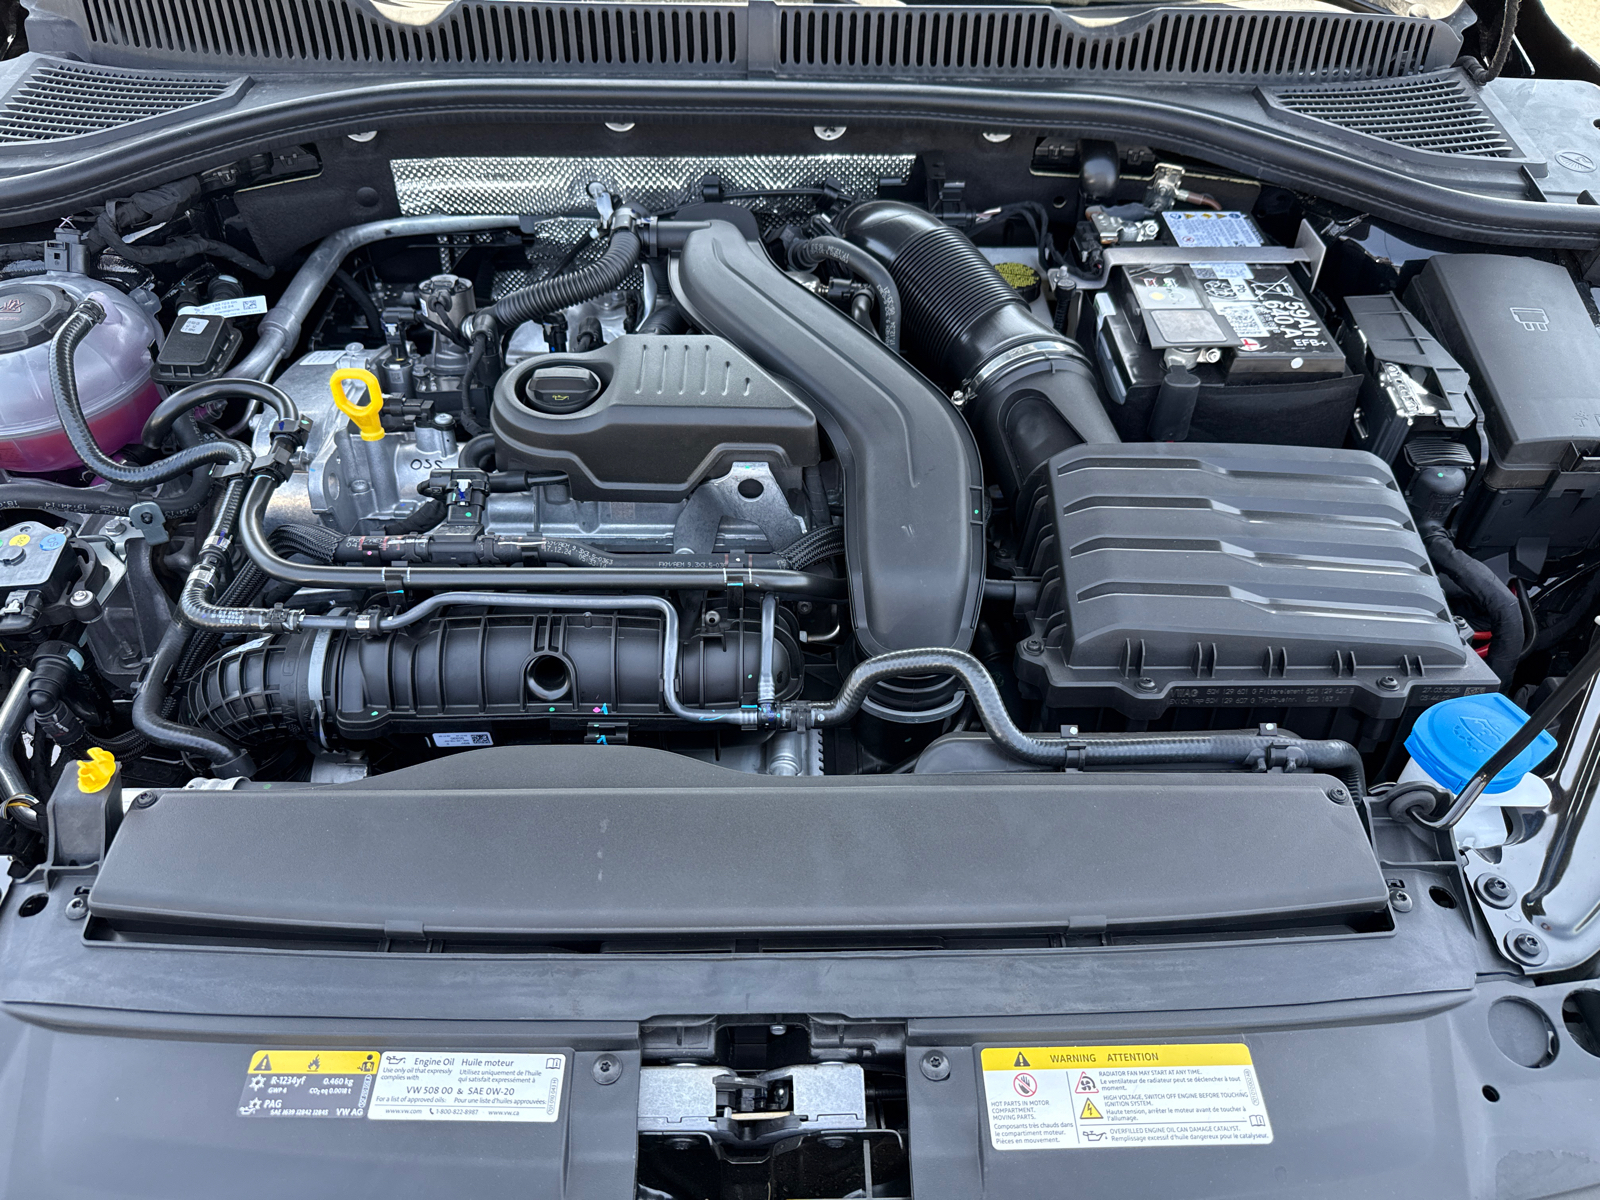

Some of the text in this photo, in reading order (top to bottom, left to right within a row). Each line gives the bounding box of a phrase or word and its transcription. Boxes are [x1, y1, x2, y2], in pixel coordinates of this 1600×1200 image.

[1284, 302, 1321, 336] 59Ah
[1050, 1052, 1159, 1062] WARNING ATTENTION
[414, 1058, 441, 1067] Engine
[270, 1076, 306, 1087] R-1234yf
[344, 1078, 354, 1087] kg
[423, 1086, 440, 1094] 508
[441, 1086, 453, 1094] 00
[263, 1100, 282, 1108] PAG
